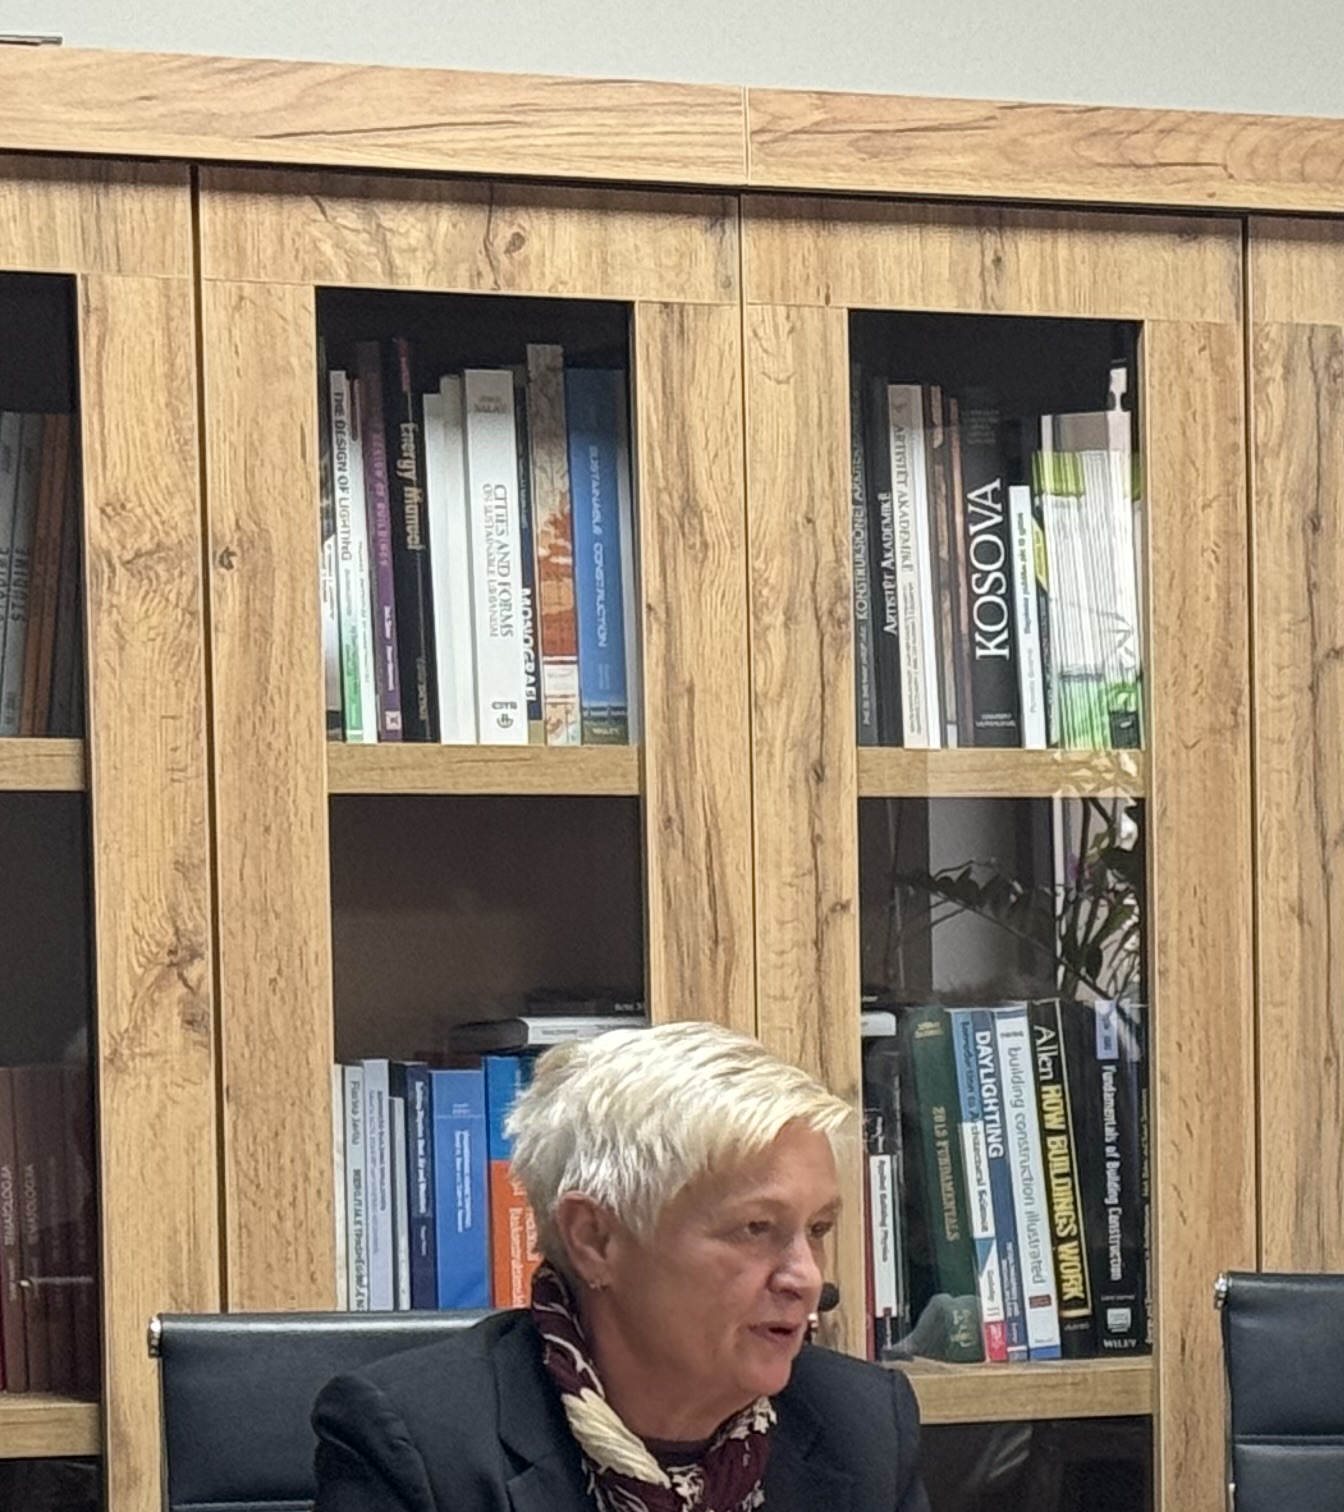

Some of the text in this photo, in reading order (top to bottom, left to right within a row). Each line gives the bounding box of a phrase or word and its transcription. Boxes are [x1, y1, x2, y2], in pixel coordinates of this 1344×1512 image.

[335, 420, 348, 472] DESIGN
[396, 422, 418, 480] Energy
[337, 475, 349, 494] OF
[338, 497, 352, 560] LIGHTING
[493, 484, 514, 638] CITIES AND FORMS
[589, 445, 608, 647] SUSTAINABLE CONSTRUCTION
[966, 477, 1010, 660] KOSOVA
[960, 1021, 979, 1094] Introduction
[974, 1030, 1004, 1158] DAYLIGHTING
[1007, 1045, 1027, 1108] building
[969, 1109, 988, 1185] Architectural
[1014, 1111, 1036, 1206] construction
[1033, 1024, 1085, 1301] Allen HOW BUILDINGS WORK
[1102, 1065, 1123, 1281] Fundamentals of Building Construction
[935, 1139, 960, 1241] FUNDAMENTALS
[975, 1189, 991, 1232] Science
[1024, 1209, 1046, 1284] illustrated
